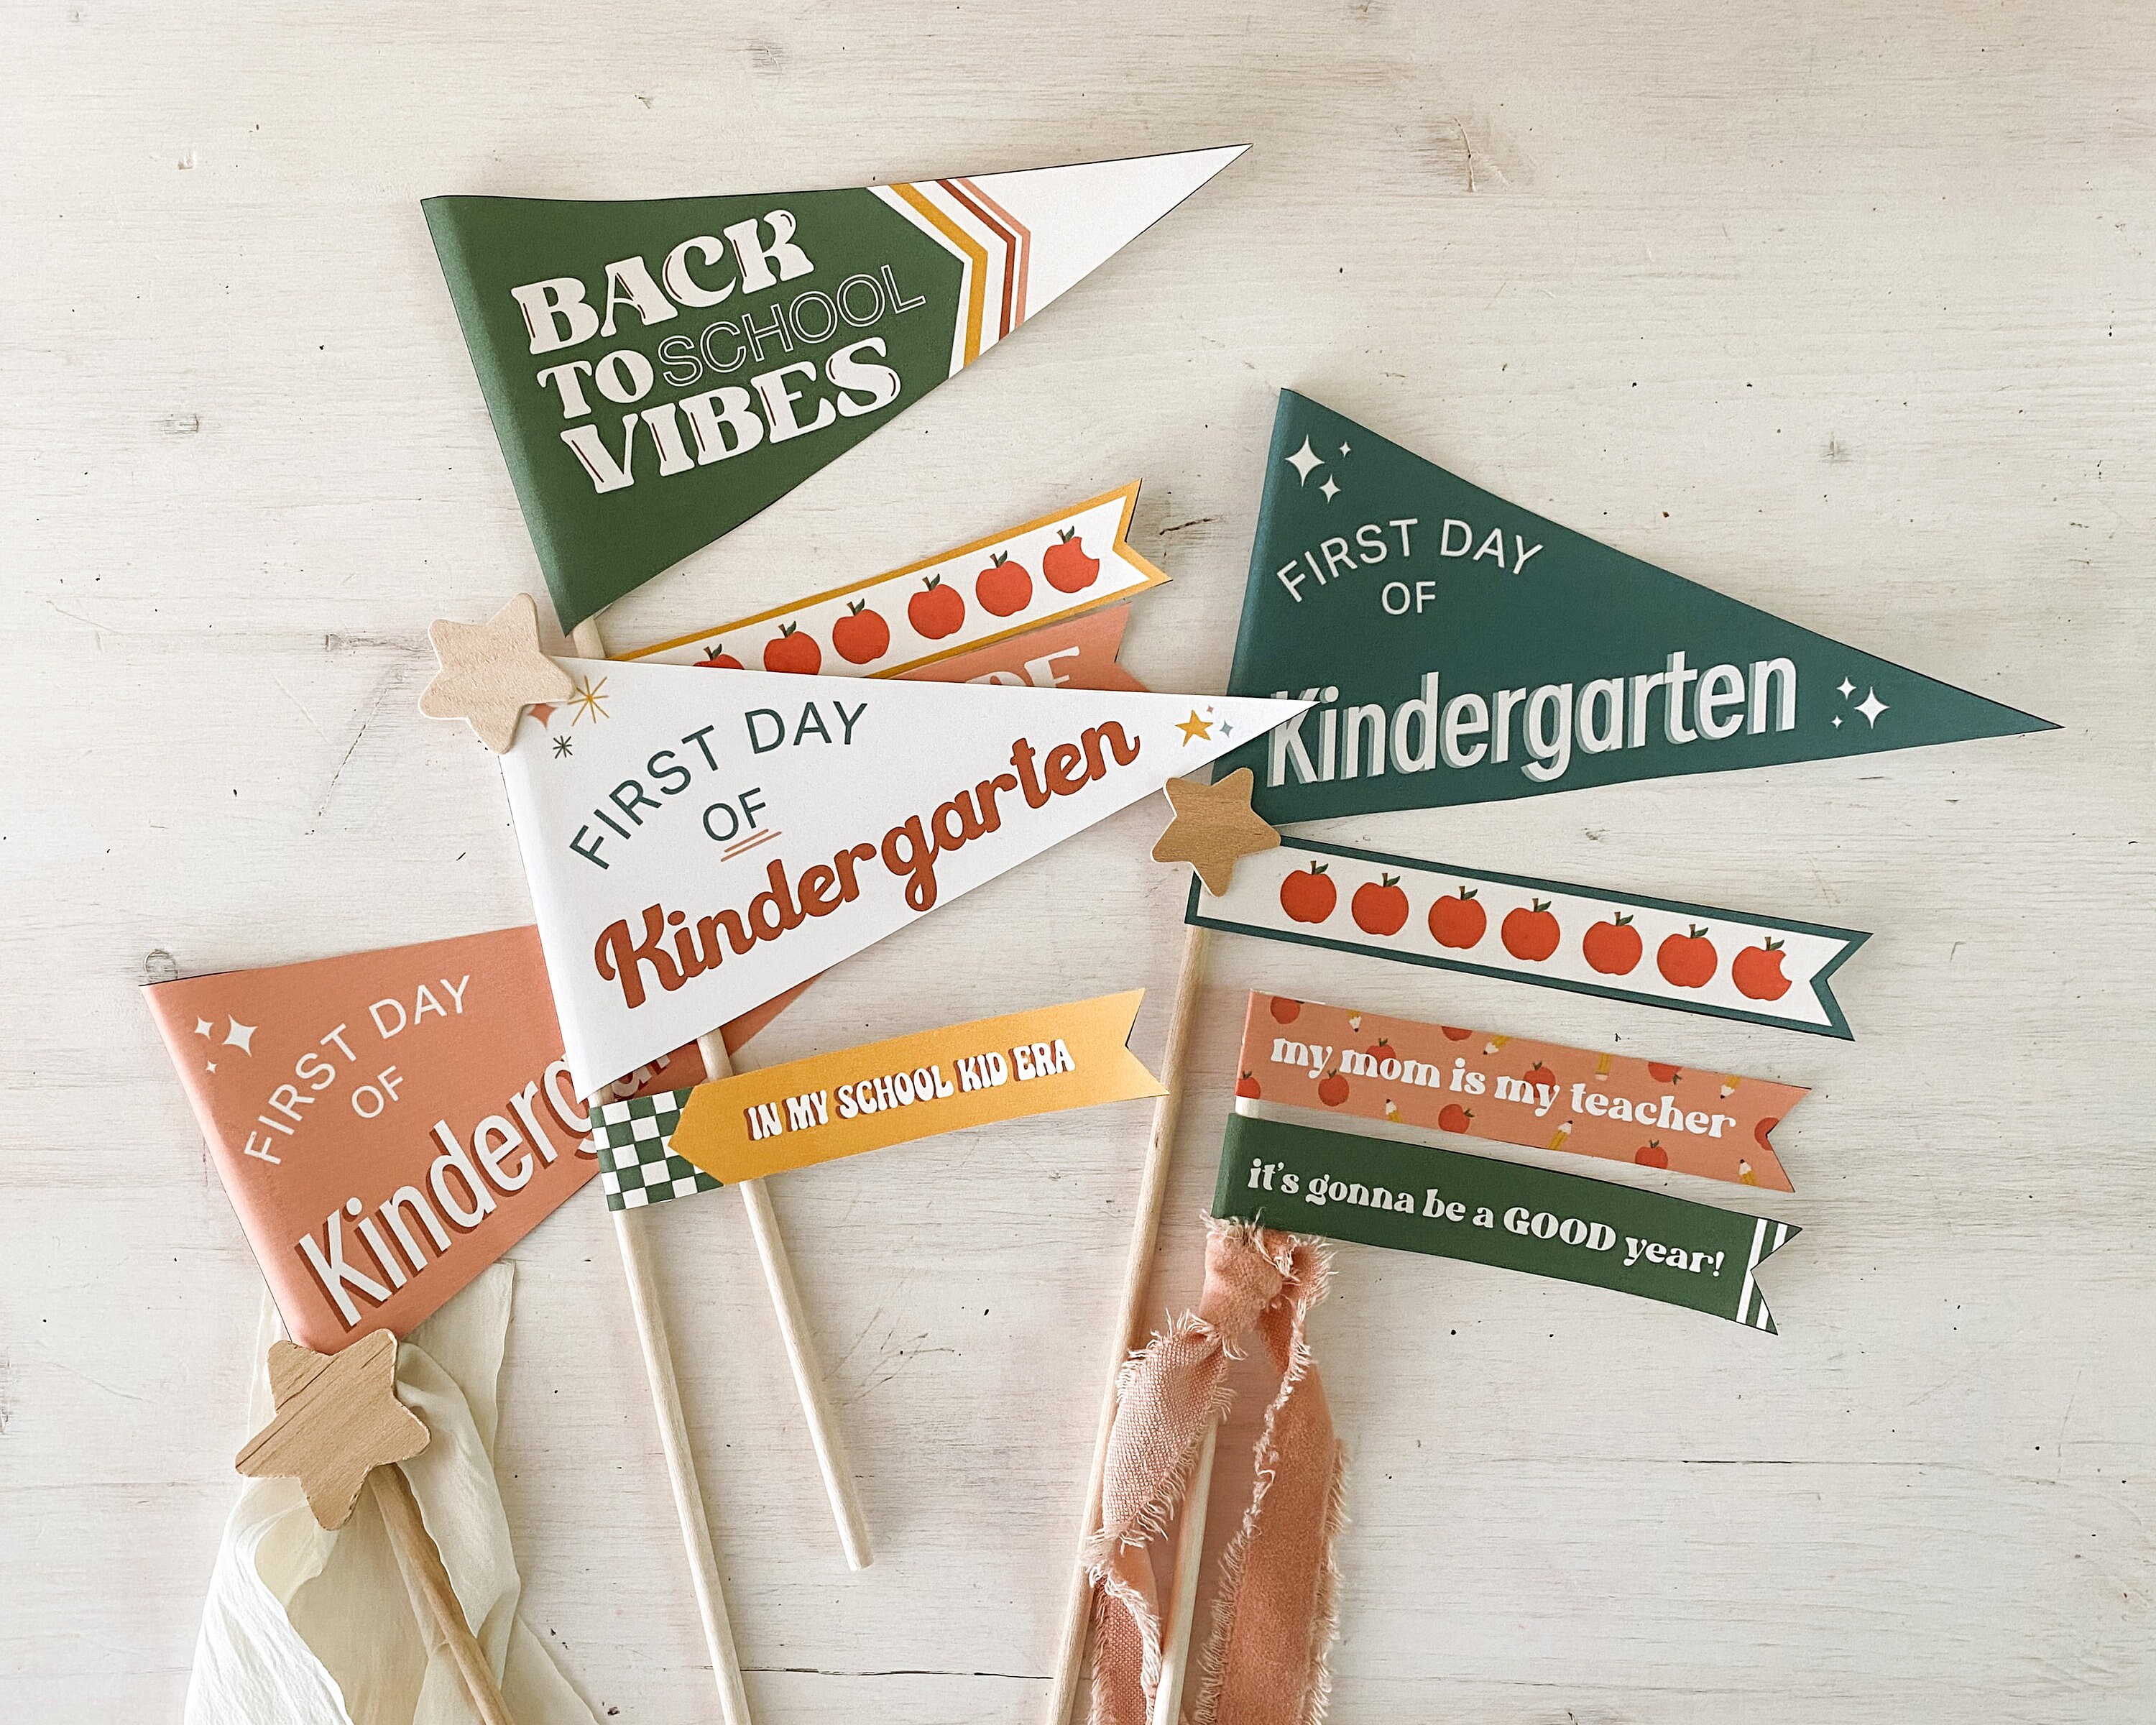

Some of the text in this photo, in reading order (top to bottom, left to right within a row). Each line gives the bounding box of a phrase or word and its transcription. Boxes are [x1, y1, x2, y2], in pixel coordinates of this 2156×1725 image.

[511, 208, 815, 355] BACK
[536, 264, 926, 419] TO SCHOOL
[560, 336, 902, 494] VIBES
[1276, 518, 1544, 602] FIRST DAY
[1381, 581, 1437, 615] OF
[1267, 650, 1798, 787] Kindergarten
[568, 701, 868, 870] FIRST DAY
[703, 787, 767, 842] OF
[594, 719, 1141, 1010] Kindergarten
[244, 975, 471, 1165] FIRST DAY
[351, 1065, 404, 1118] OF
[744, 1039, 1076, 1141] IN MY SCHOOL KID ERA
[1271, 1036, 1737, 1138] my mom is my teacher
[1247, 1158, 1726, 1278] it's gonna be a GOOD year!
